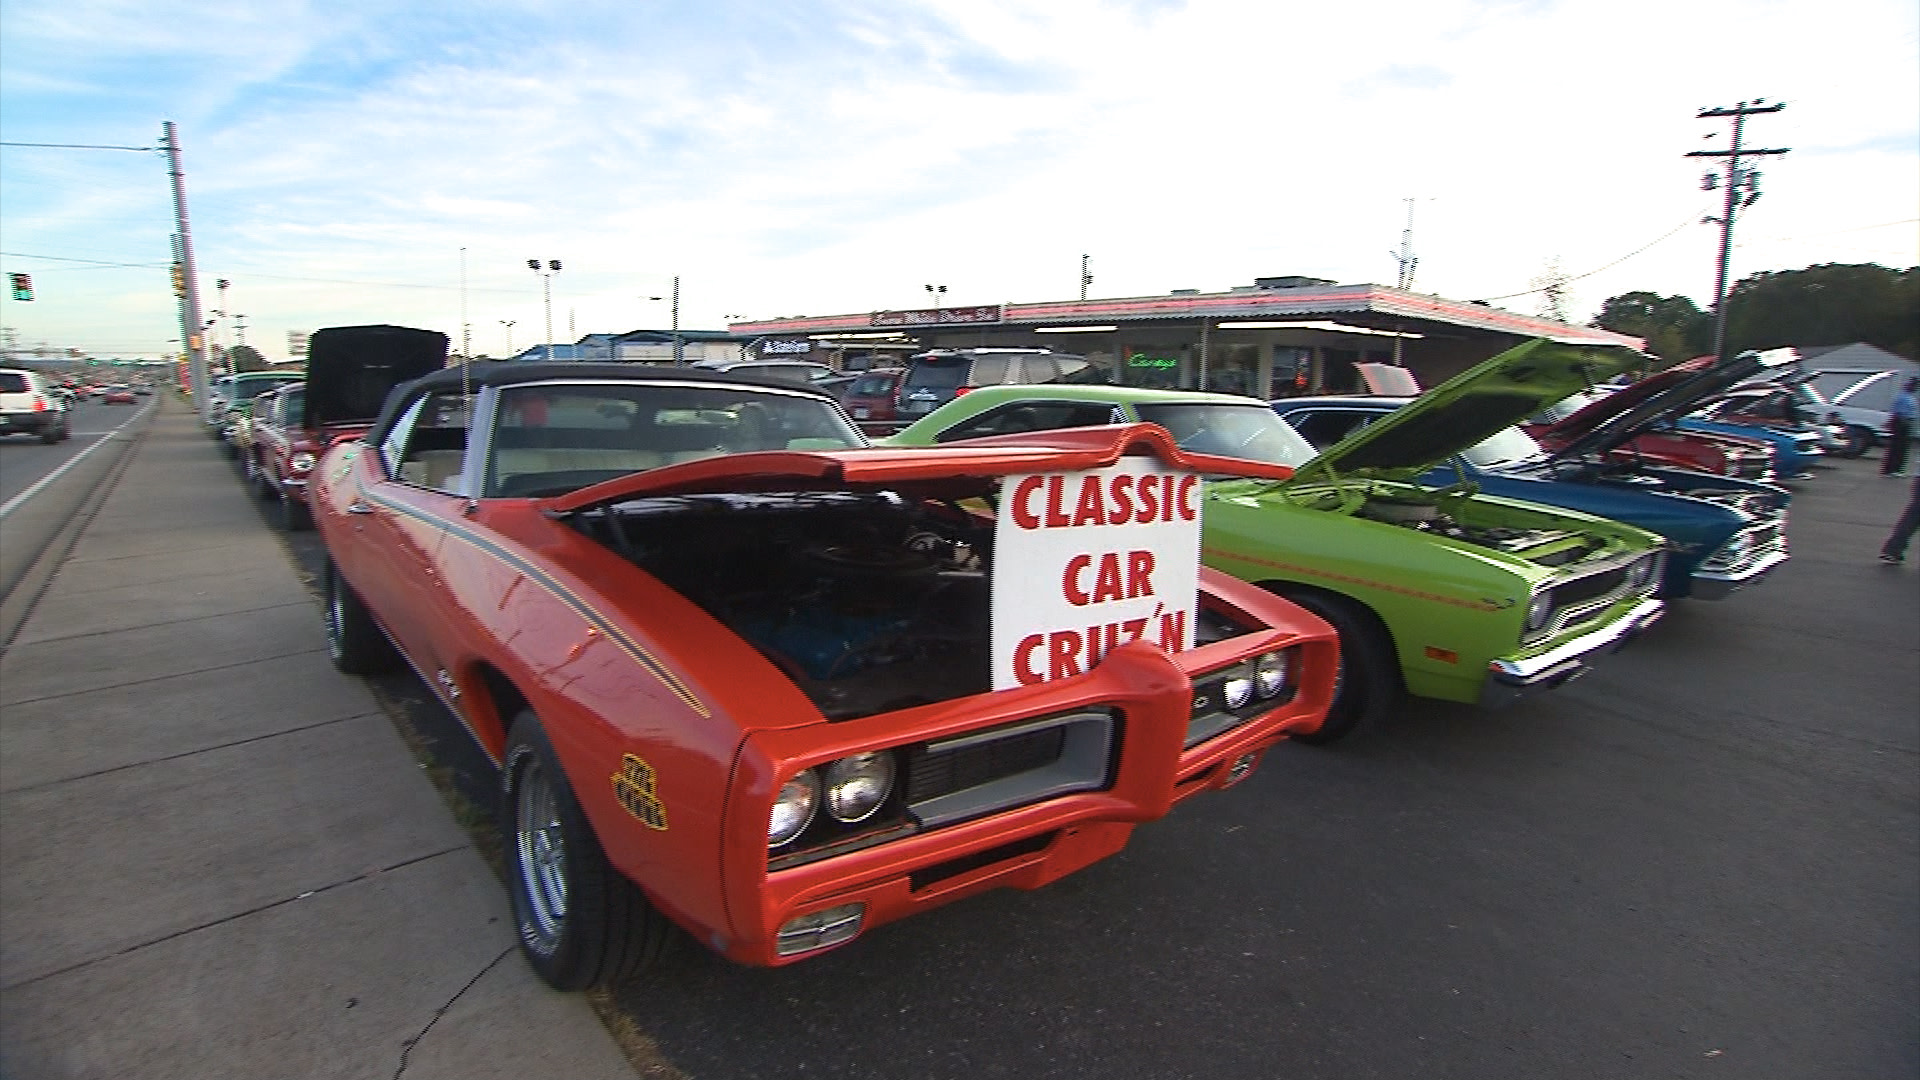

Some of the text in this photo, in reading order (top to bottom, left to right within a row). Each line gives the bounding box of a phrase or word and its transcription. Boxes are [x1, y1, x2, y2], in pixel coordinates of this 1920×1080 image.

[904, 310, 937, 325] White
[938, 309, 974, 323] Drive
[1010, 474, 1197, 530] CLASSIC
[1061, 549, 1157, 606] CAR
[624, 755, 654, 794] THE
